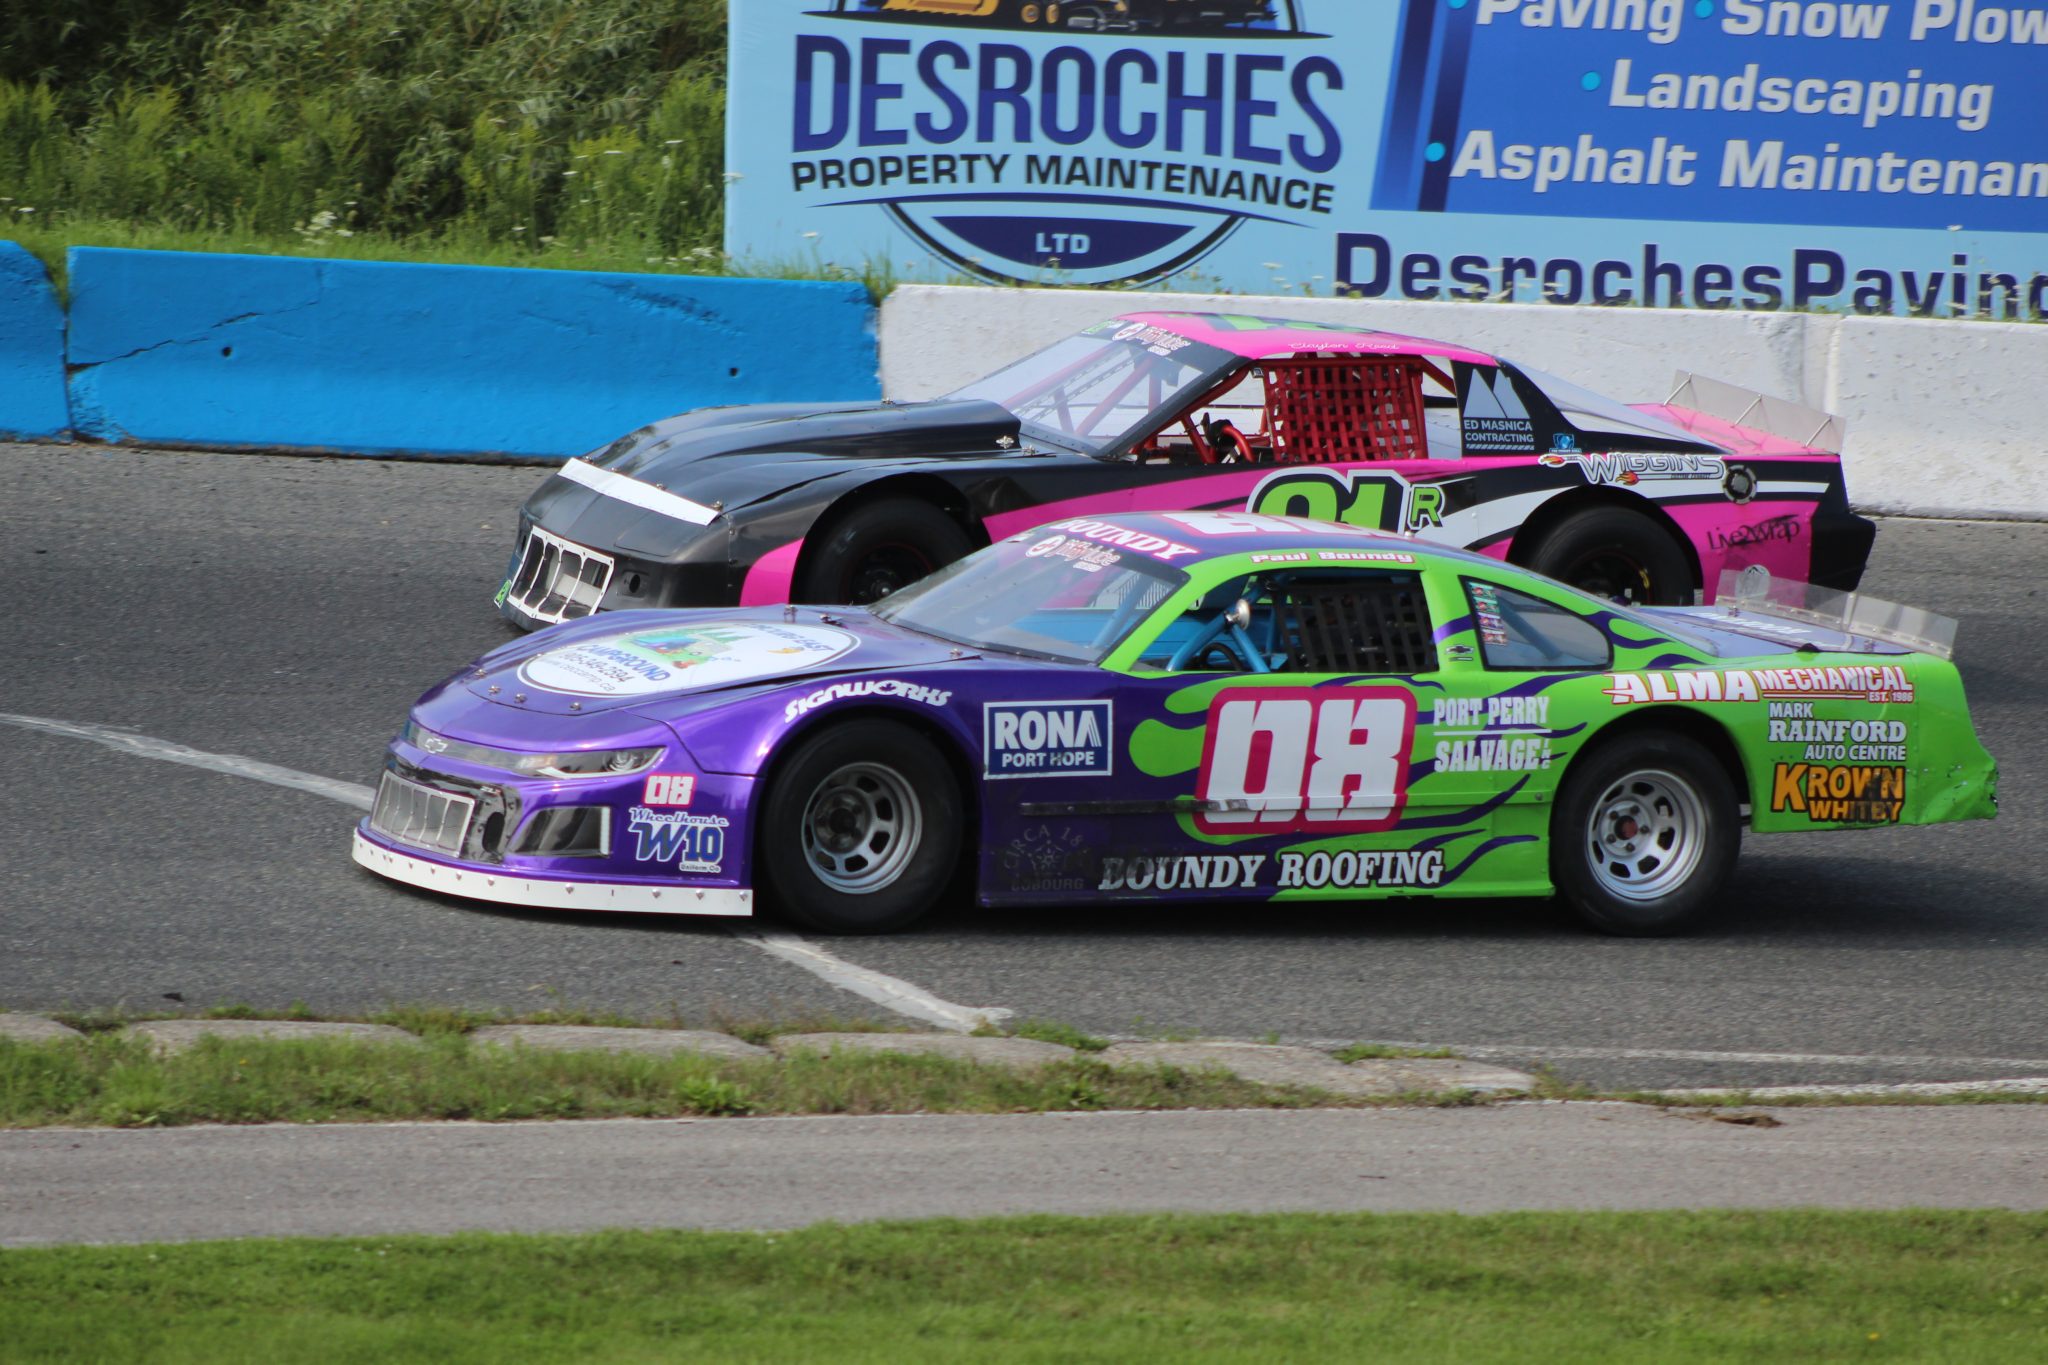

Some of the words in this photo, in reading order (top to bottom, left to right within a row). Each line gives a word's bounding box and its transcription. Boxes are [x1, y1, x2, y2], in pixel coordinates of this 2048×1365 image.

[1475, 0, 1682, 44] Paving
[1721, 0, 1890, 39] Snow
[793, 34, 1344, 174] DESROCHES
[1608, 59, 1995, 131] Landscaping
[1450, 130, 1698, 194] Asphalt
[1719, 140, 2048, 198] Maintenan
[791, 153, 1010, 192] PROPERTY
[1024, 154, 1335, 215] MAINTENANCE
[1036, 232, 1090, 254] LTD
[1464, 420, 1479, 430] ED
[1481, 420, 1533, 431] MASNICA
[1465, 432, 1534, 443] CONTRACTING
[1578, 453, 1726, 485] WIGGINS
[1049, 519, 1200, 560] BOUNDY
[1250, 552, 1309, 563] Paul
[1318, 552, 1416, 564] Boundy
[1602, 671, 1760, 705] ALMA
[1752, 666, 1914, 692] MECHANICAL
[1433, 698, 1483, 726] PORT
[1487, 695, 1549, 725] PERRY
[1769, 702, 1813, 719] MARK
[994, 710, 1102, 751] RONA
[1768, 720, 1907, 743] RAINFORD
[1001, 752, 1046, 768] PORT
[1049, 751, 1095, 766] HOPE
[1203, 697, 1407, 824] 08
[1434, 738, 1540, 773] SALVAGE
[1804, 745, 1845, 760] AUTO
[1848, 744, 1907, 761] CENTRE
[645, 775, 694, 805] 08
[1772, 764, 1905, 811] KROWN
[628, 808, 729, 826] Wheelhouse
[629, 821, 723, 864] W10
[1277, 850, 1444, 888] ROOFING
